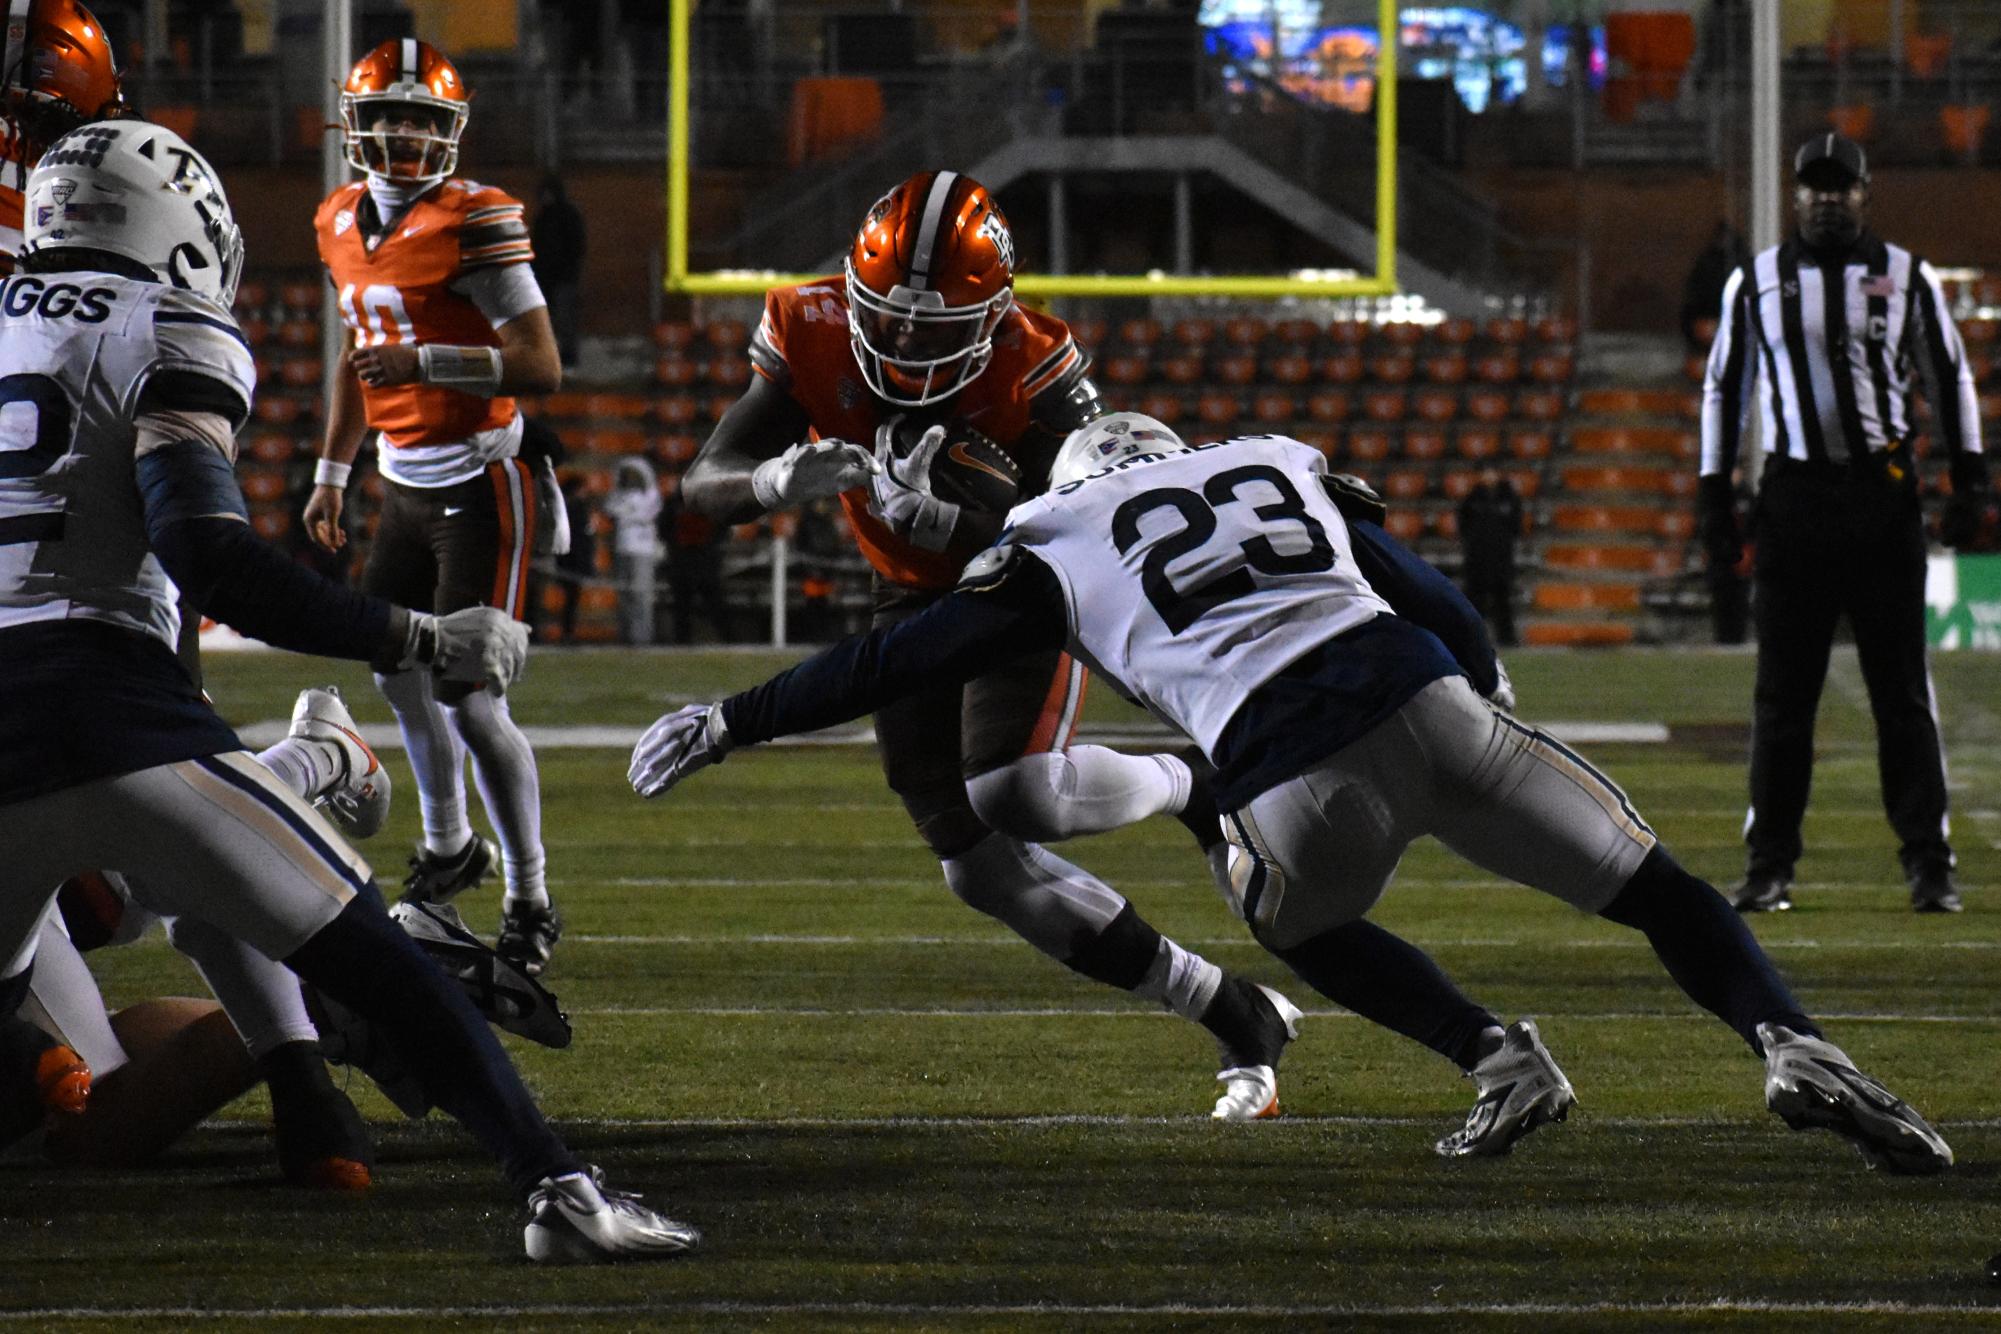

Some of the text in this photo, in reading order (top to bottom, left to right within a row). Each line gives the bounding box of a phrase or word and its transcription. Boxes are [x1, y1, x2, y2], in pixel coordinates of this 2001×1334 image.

[339, 283, 418, 349] 10
[0, 373, 72, 546] 2
[1111, 464, 1335, 637] 23
